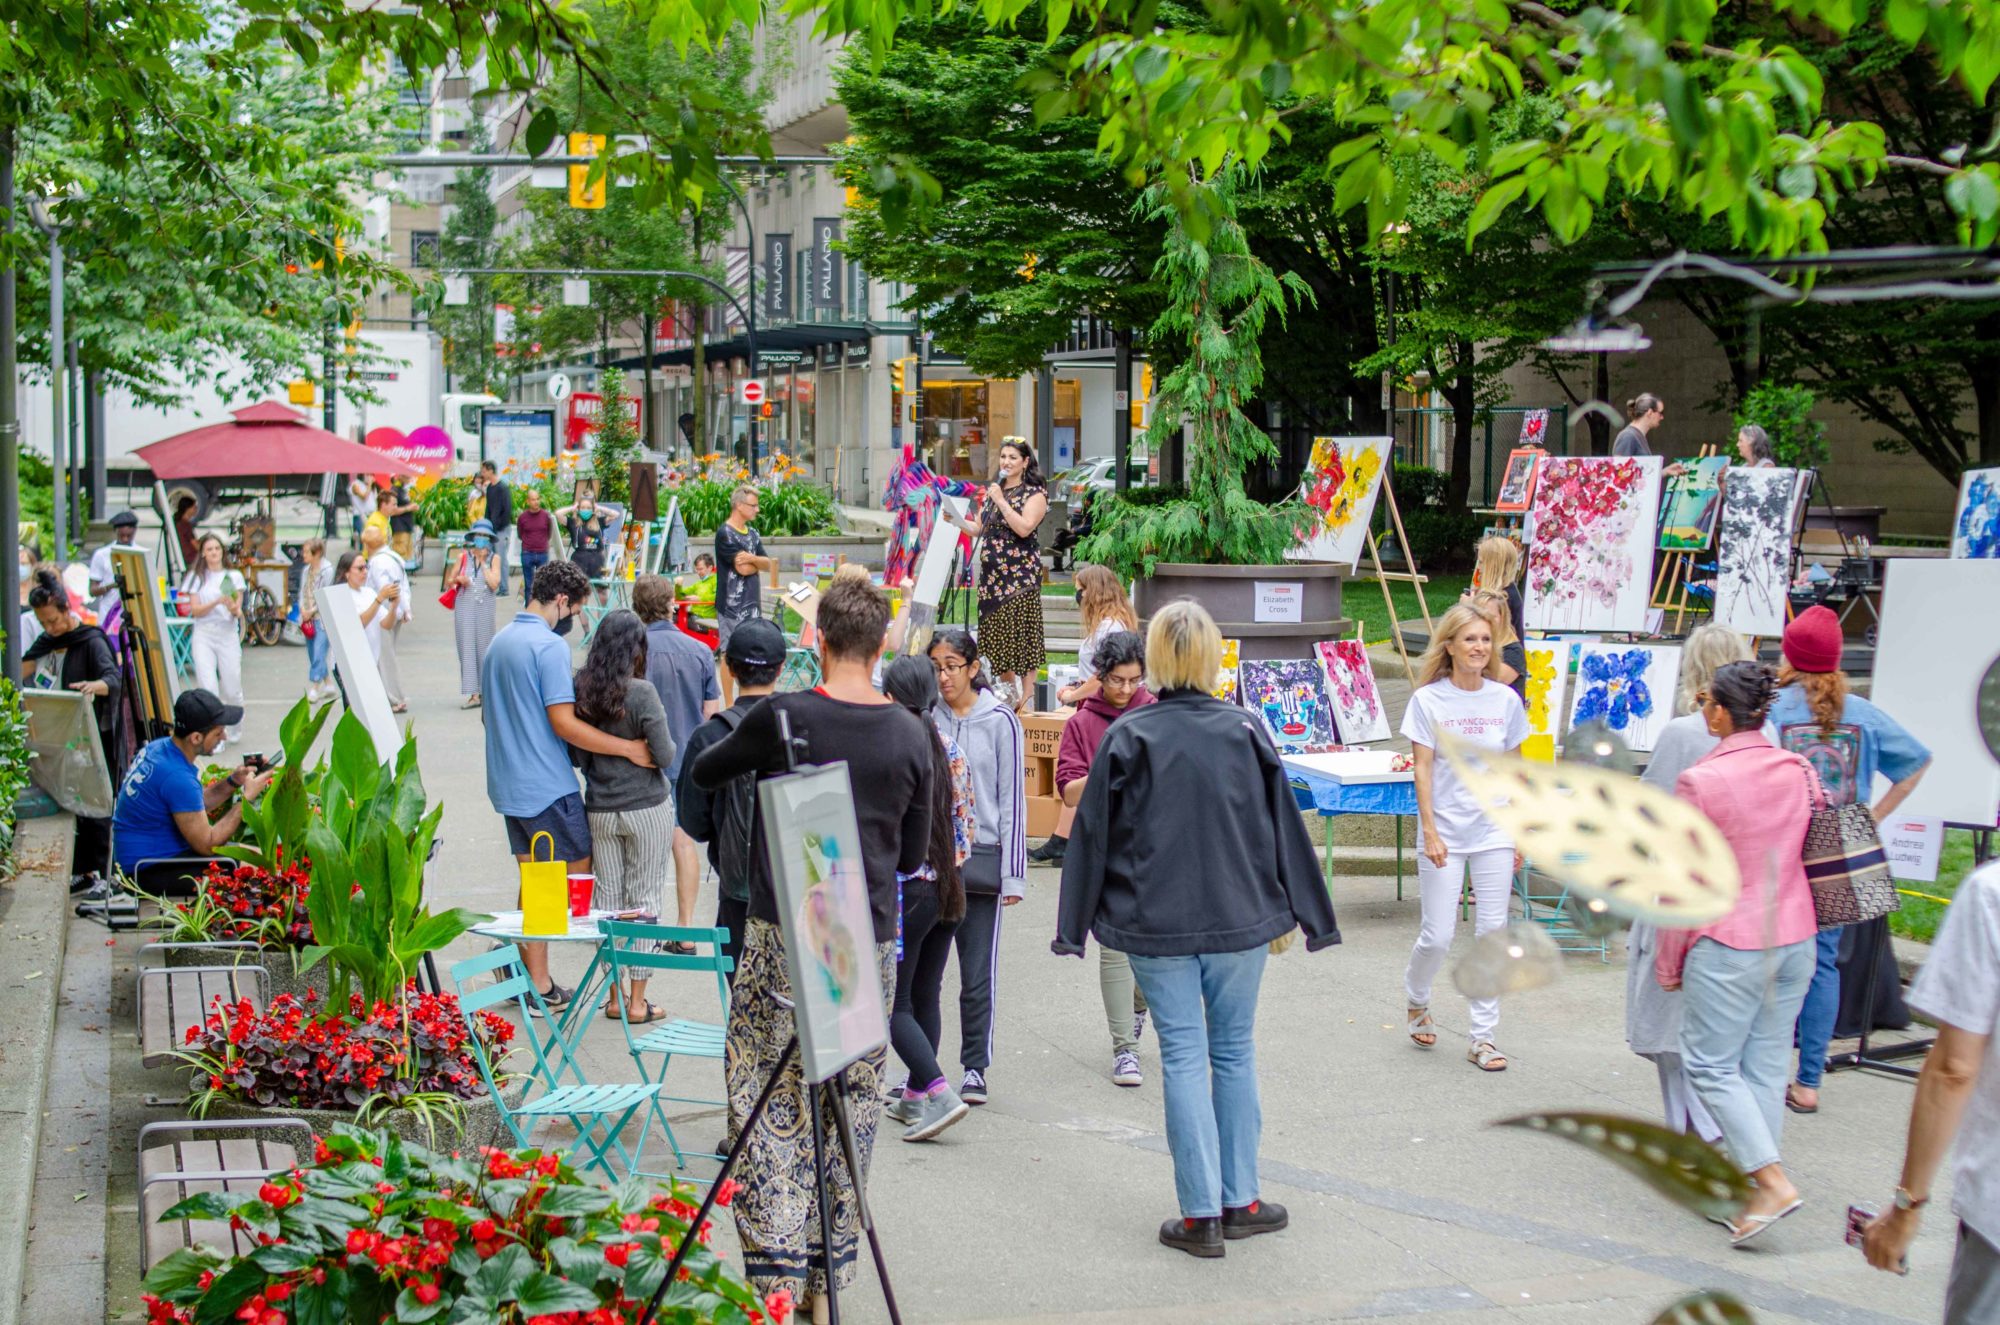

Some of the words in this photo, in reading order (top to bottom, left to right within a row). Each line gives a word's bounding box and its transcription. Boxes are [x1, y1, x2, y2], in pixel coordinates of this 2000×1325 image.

[823, 226, 832, 299] PALLADIO
[774, 242, 783, 310] PALLADIO
[414, 446, 448, 458] Hands
[1457, 717, 1504, 726] VANCOUVER
[1024, 729, 1062, 741] YSTER
[1033, 743, 1052, 754] BOX
[1891, 838, 1924, 850] Andrea
[1890, 851, 1922, 866] Ludwig
